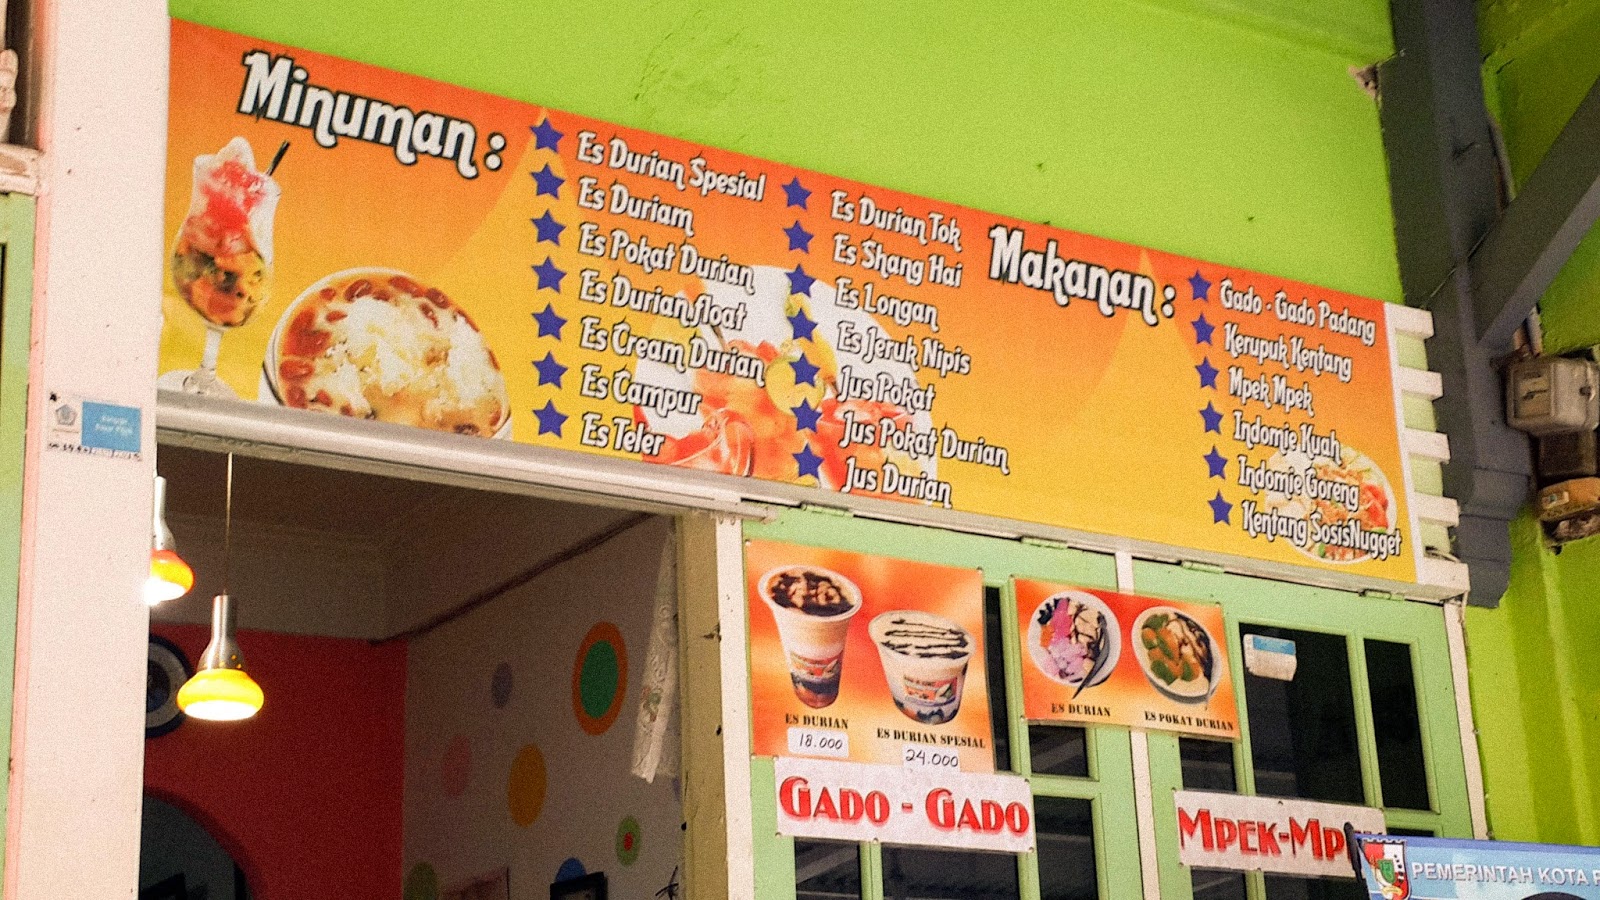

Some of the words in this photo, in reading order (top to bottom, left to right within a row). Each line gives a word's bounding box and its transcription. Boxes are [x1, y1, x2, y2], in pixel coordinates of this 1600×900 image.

[236, 49, 479, 180] Minuman
[577, 130, 605, 165] Es
[608, 135, 686, 191] Durian
[689, 153, 767, 201] Spesial
[578, 175, 606, 211] Es
[830, 189, 855, 222] Es
[858, 192, 929, 246] Durian
[928, 211, 963, 253] Tok
[578, 221, 607, 257] Es
[609, 228, 676, 274] Pokat
[679, 237, 756, 296] Durian
[579, 267, 608, 304] Es
[833, 232, 858, 266] Es
[861, 232, 925, 287] Shang
[928, 253, 963, 288] Hai
[988, 223, 1159, 327] Makanan
[835, 275, 860, 310] Es
[863, 281, 940, 333] Longan
[1219, 276, 1263, 316] Gado
[1273, 287, 1317, 327] Gado
[1317, 299, 1377, 347] Padang
[579, 315, 609, 351] Es
[611, 316, 686, 374] Cream
[688, 329, 767, 388] Durian
[836, 320, 863, 354] Es
[862, 325, 920, 373] Jeruk
[921, 337, 972, 378] Nipis
[1223, 320, 1291, 370] Kerupuk
[1289, 334, 1354, 384] Kentang
[580, 363, 610, 400] Es
[611, 364, 703, 418] Campur
[836, 364, 875, 403] Jus
[876, 371, 936, 415] Pokat
[1227, 365, 1272, 410] Mpek
[1271, 373, 1316, 418] Mpek
[581, 411, 610, 449] Es
[612, 415, 666, 457] Teler
[838, 410, 877, 449] Jus
[878, 416, 939, 461] Pokat
[940, 421, 1011, 477] Durian
[1233, 409, 1299, 457] Indomie
[1299, 422, 1344, 469] Kuah
[840, 455, 879, 494] Jus
[881, 456, 953, 510] Durian
[1237, 453, 1304, 501] Indomie
[1303, 464, 1361, 513] Goreng
[1241, 499, 1309, 548] Kentang
[785, 712, 800, 725] ES
[803, 714, 850, 731] DURIAN
[1051, 703, 1066, 714] ES
[1068, 704, 1112, 717] DURIAN
[1144, 710, 1156, 722] ES
[1159, 714, 1194, 727] POKAT
[1196, 717, 1235, 732] DURIAN
[799, 732, 844, 752] 18.000
[876, 727, 891, 740] ES
[893, 730, 938, 745] DURIAN
[940, 735, 987, 750] SPESIAL
[905, 748, 960, 769] 24.000
[1177, 806, 1352, 863] MPEK-MP
[1411, 861, 1535, 883] PEMERINTAH
[1538, 867, 1590, 886] KOTA
